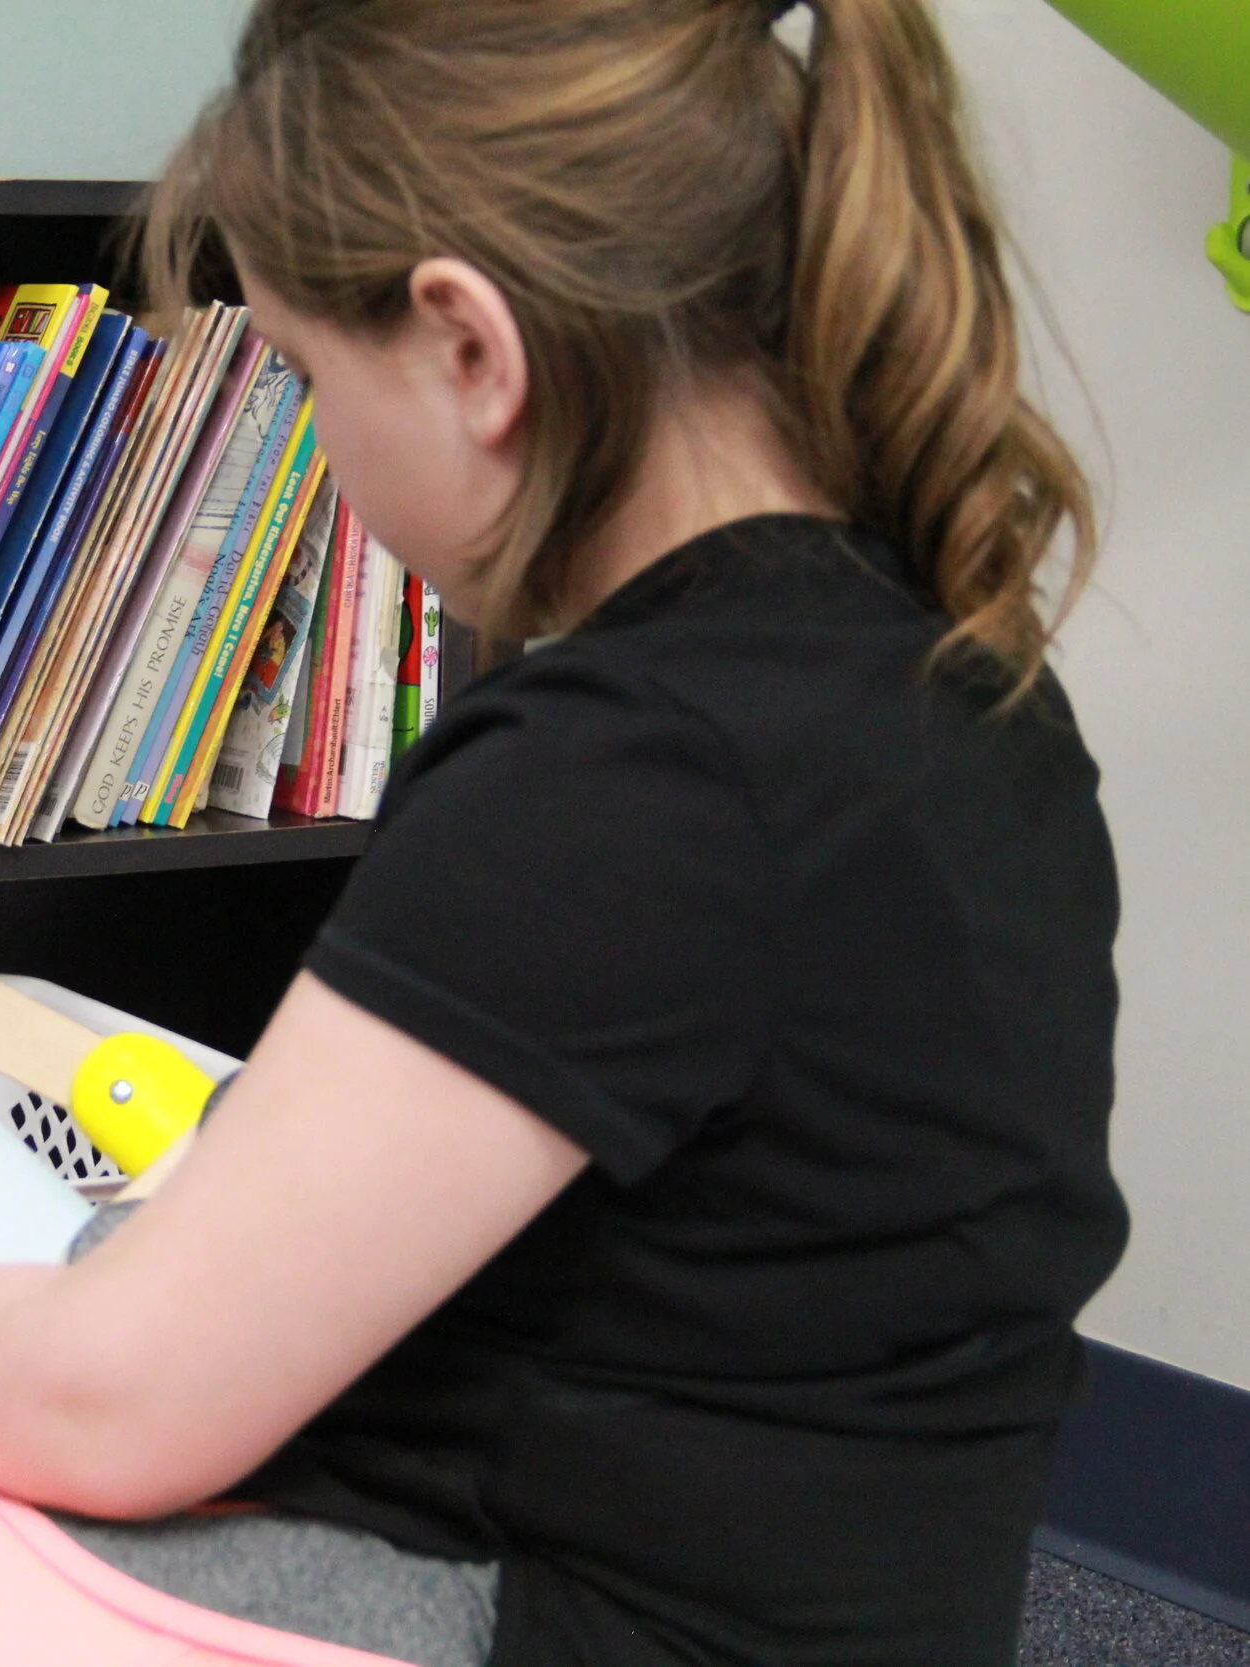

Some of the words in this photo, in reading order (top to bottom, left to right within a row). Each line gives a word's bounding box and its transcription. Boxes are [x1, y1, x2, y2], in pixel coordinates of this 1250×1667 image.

[123, 348, 138, 376] BIBLE
[108, 376, 126, 410] JUMBO
[86, 410, 111, 460] COLORING
[21, 450, 35, 475] Lights
[63, 468, 86, 513] ACTIVITY
[284, 470, 300, 500] Look
[50, 514, 66, 543] BOOK
[274, 501, 287, 524] Out
[197, 551, 228, 606] Noah's
[185, 610, 203, 641] Ark
[232, 604, 248, 632] Here
[214, 641, 233, 678] Come!
[91, 771, 117, 816] GOD
[110, 714, 138, 766] KEEPS
[132, 677, 153, 709] HIS
[147, 593, 187, 673] PROMISE
[324, 698, 340, 803] Martin/Archambault/Ehlert
